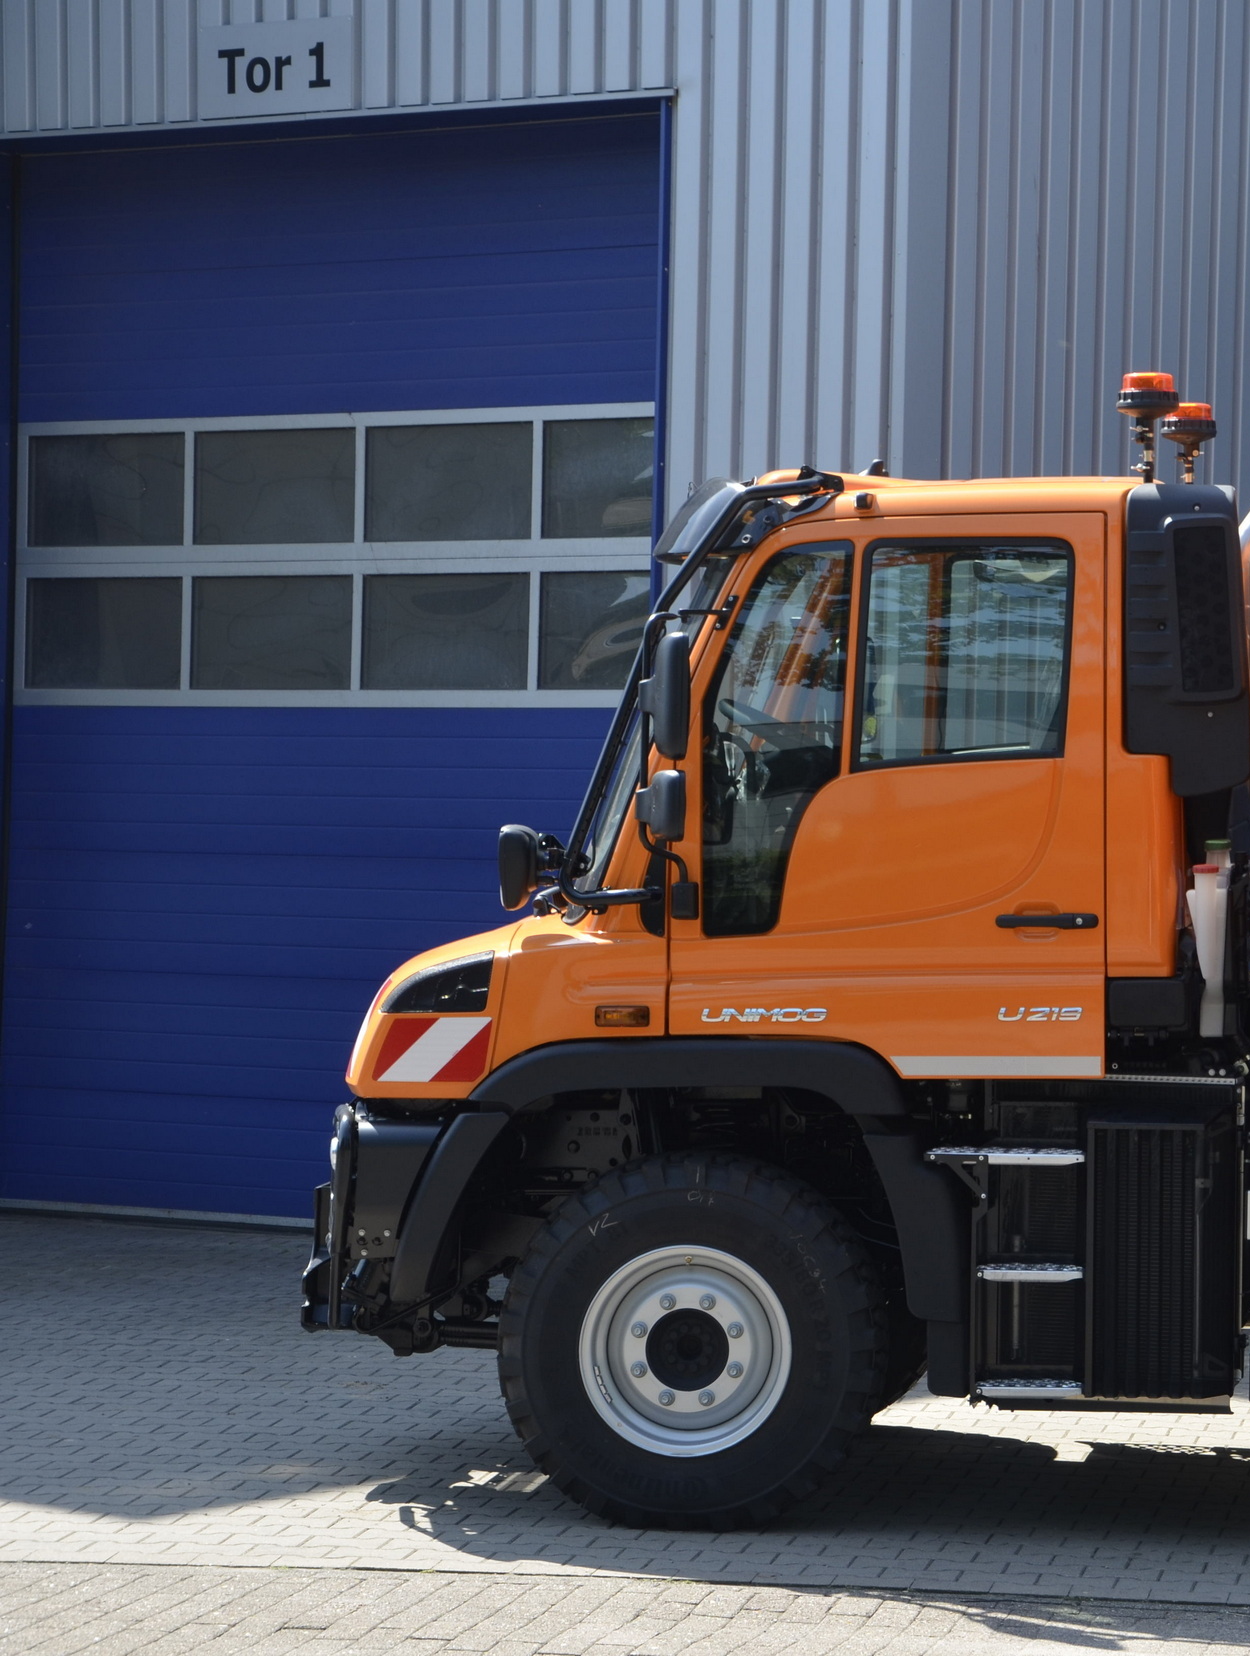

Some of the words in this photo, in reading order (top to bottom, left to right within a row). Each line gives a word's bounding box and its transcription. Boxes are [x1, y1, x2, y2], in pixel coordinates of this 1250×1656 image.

[218, 48, 292, 94] Tor
[308, 41, 331, 88] 1
[701, 1008, 827, 1022] UNIMOG
[1026, 1007, 1083, 1022] 219
